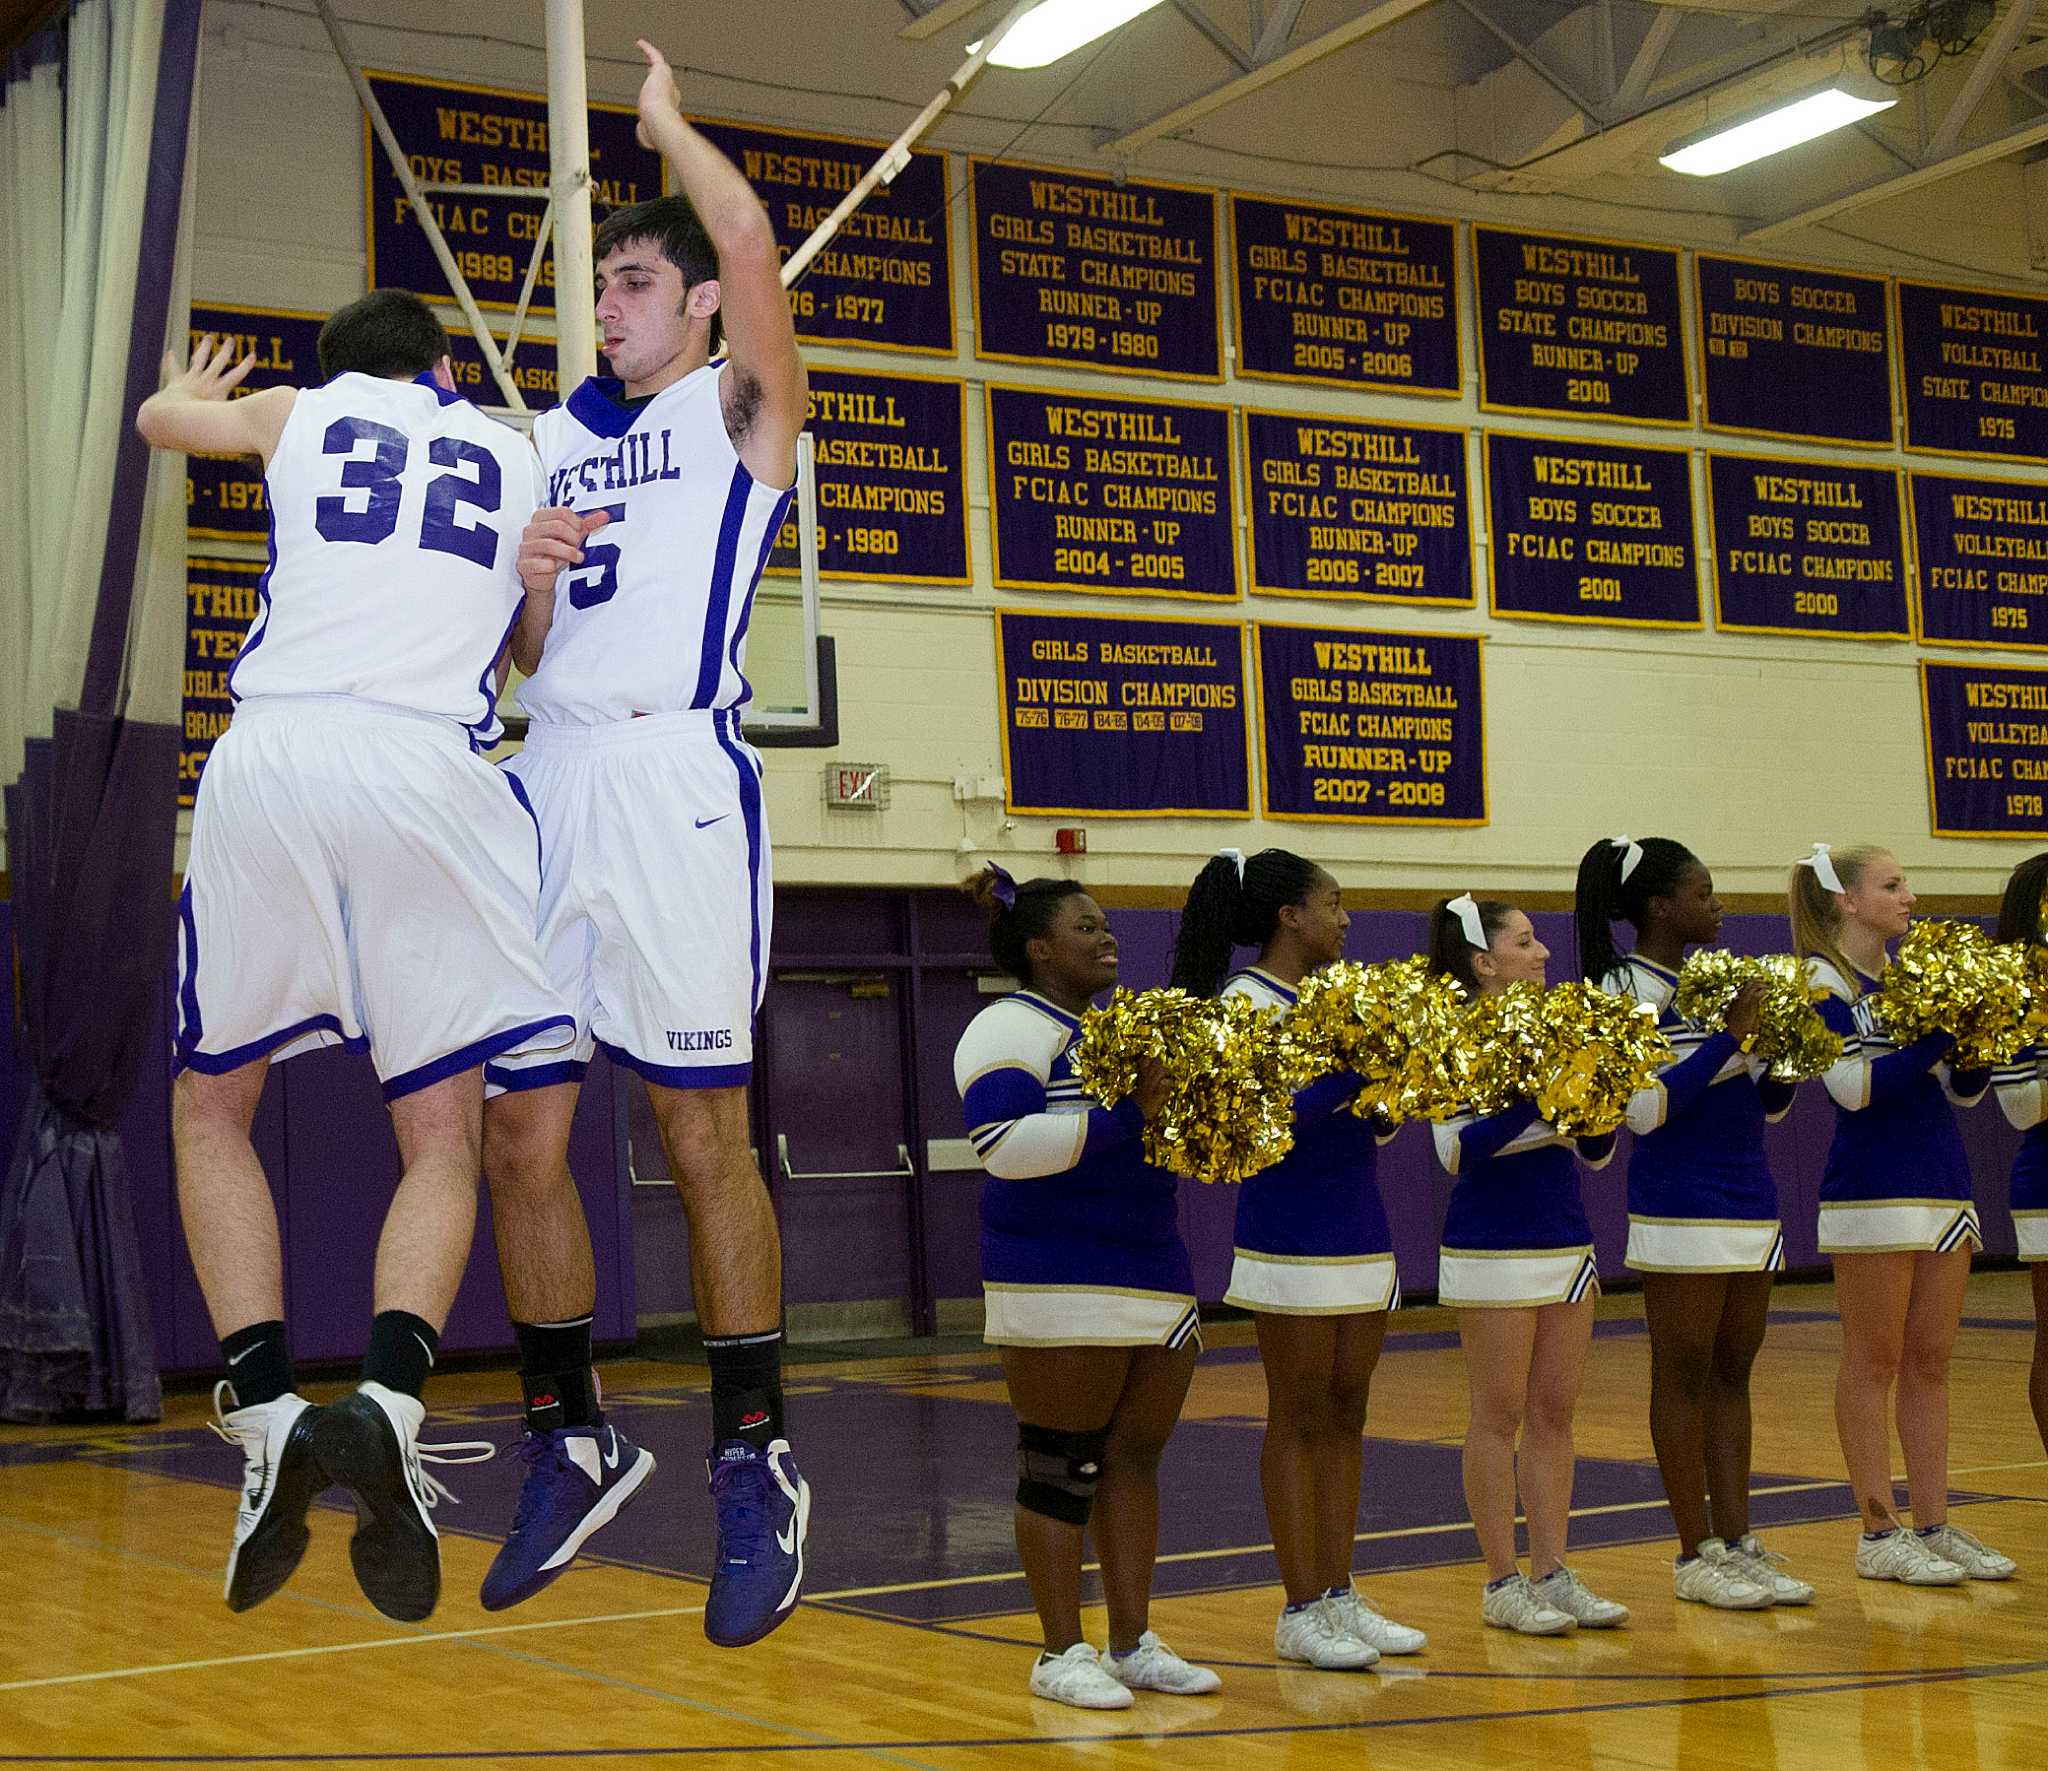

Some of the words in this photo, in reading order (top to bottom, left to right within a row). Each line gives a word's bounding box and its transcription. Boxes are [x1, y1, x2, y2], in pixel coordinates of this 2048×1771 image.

[1029, 180, 1164, 227] WESTHILL
[990, 214, 1055, 245] GIRLS
[1067, 223, 1202, 264] BASKETBALL
[1284, 213, 1409, 255] WESTHILL
[1000, 250, 1065, 280] STATE
[1081, 259, 1195, 296] CHAMPIONS
[1250, 245, 1308, 273] GIRLS
[1321, 252, 1445, 288] BASKETBALL
[1522, 245, 1640, 284] WESTHILL
[1254, 276, 1325, 306] FCIAC
[1338, 286, 1444, 319] CHAMPIONS
[1515, 279, 1565, 306] BOYS
[1577, 286, 1648, 314] SOCCER
[1733, 278, 1781, 304] BOYS
[1791, 286, 1857, 314] SOCCER
[1498, 308, 1556, 336] STATE
[1567, 316, 1667, 347] CHAMPIONS
[1709, 312, 1784, 341] DIVISION
[1793, 323, 1883, 352] CHAMPIONS
[1940, 304, 2038, 337] WESTHILL
[1941, 342, 2041, 372] VOLLEYBALL
[1567, 378, 1611, 404] 2001
[1923, 376, 1970, 399] STATE
[1980, 381, 2048, 408] CHAMPIO
[1045, 406, 1181, 444] WESTHILL
[1979, 416, 2015, 440] 1975
[812, 437, 948, 473] ASKETBALL
[1008, 440, 1070, 470] GIRLS
[1085, 448, 1218, 481] BASKETBALL
[1297, 428, 1420, 464] WESTHILL
[1263, 459, 1321, 487] GIRLS
[1335, 465, 1456, 498] BASKETBALL
[1533, 455, 1652, 491] WESTHILL
[315, 416, 502, 570] 32
[820, 483, 945, 515] CHAMPIONS
[1012, 476, 1089, 506] FCIAC
[1103, 484, 1216, 514] CHAMPIONS
[1754, 475, 1863, 509] WESTHILL
[1268, 491, 1338, 519] FCIAC
[1351, 499, 1455, 528] CHAMPIONS
[1529, 497, 1577, 523] BOYS
[1591, 502, 1663, 529] SOCCER
[1748, 515, 1794, 540] BOYS
[1806, 520, 1871, 545] SOCCER
[1954, 533, 2048, 560] VOLLEYBAL
[568, 502, 627, 611] 5
[1507, 533, 1574, 560] FCIAC
[1586, 539, 1684, 568] CHAMPIONS
[1730, 550, 1792, 575] FCIAC
[1802, 555, 1893, 581] CHAMPIONS
[1579, 577, 1622, 602] 2001
[1931, 566, 1989, 590] FCIAC
[1794, 591, 1839, 616] 2000
[1991, 606, 2028, 629] 1975
[1031, 639, 1089, 662] GIRLS
[1100, 643, 1216, 667] BASKETBALL
[1313, 641, 1432, 676] WESTHILL
[1017, 678, 1108, 704] DIVISION
[1121, 682, 1236, 708] CHAMPIONS
[1291, 677, 1342, 702] GIRLS
[1347, 681, 1458, 709] BASKETBALL
[1965, 683, 2048, 710] WESTHIL
[1300, 711, 1350, 736] FCIAC
[1357, 714, 1452, 741] CHAMPIONS
[1945, 757, 2004, 779] FCIAC
[2006, 794, 2043, 817] 1978
[666, 1029, 733, 1051] VIKINGS
